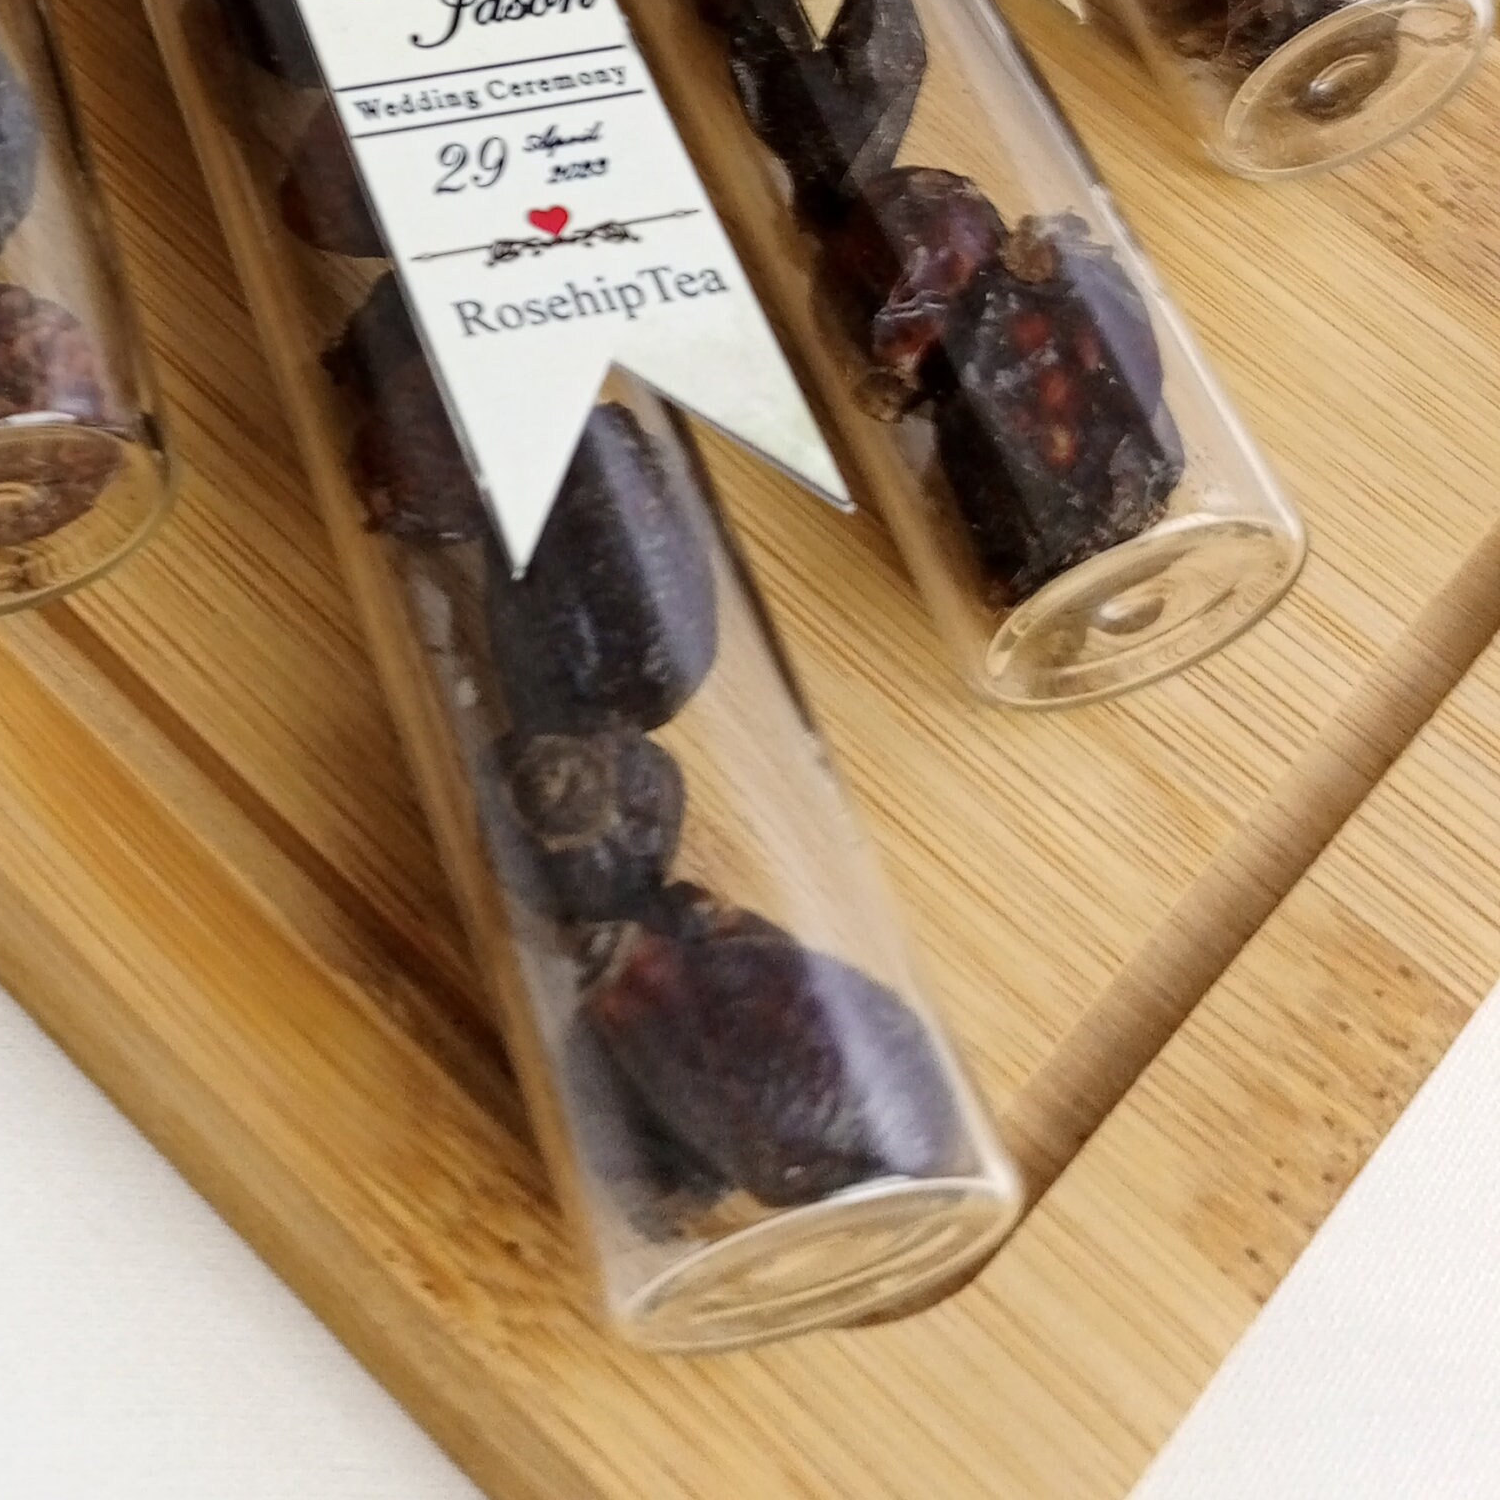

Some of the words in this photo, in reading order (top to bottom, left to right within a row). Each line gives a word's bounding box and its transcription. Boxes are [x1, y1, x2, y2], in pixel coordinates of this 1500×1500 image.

[354, 88, 482, 122] Wedding
[485, 64, 628, 102] Ceremony
[432, 135, 510, 195] 29
[453, 262, 732, 338] RosehipTea
